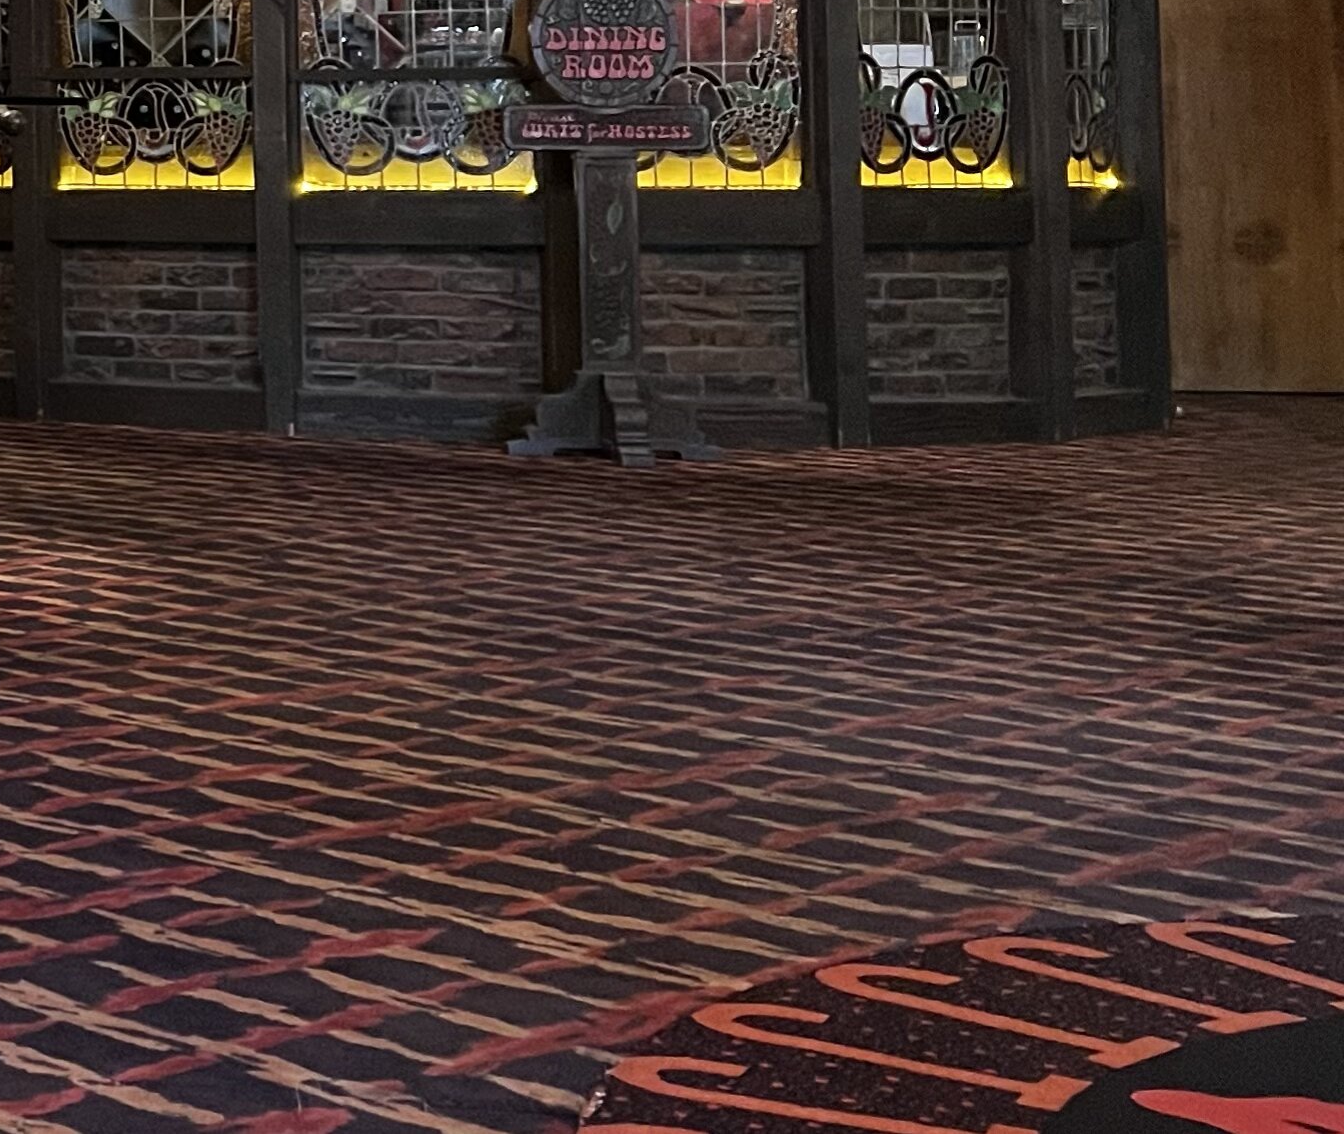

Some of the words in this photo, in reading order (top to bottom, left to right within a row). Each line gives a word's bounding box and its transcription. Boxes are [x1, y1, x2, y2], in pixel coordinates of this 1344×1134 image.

[545, 26, 666, 51] DINING
[562, 53, 655, 79] ROOM
[521, 123, 584, 139] WAIT
[587, 122, 608, 144] for
[608, 123, 694, 139] HOSTESS
